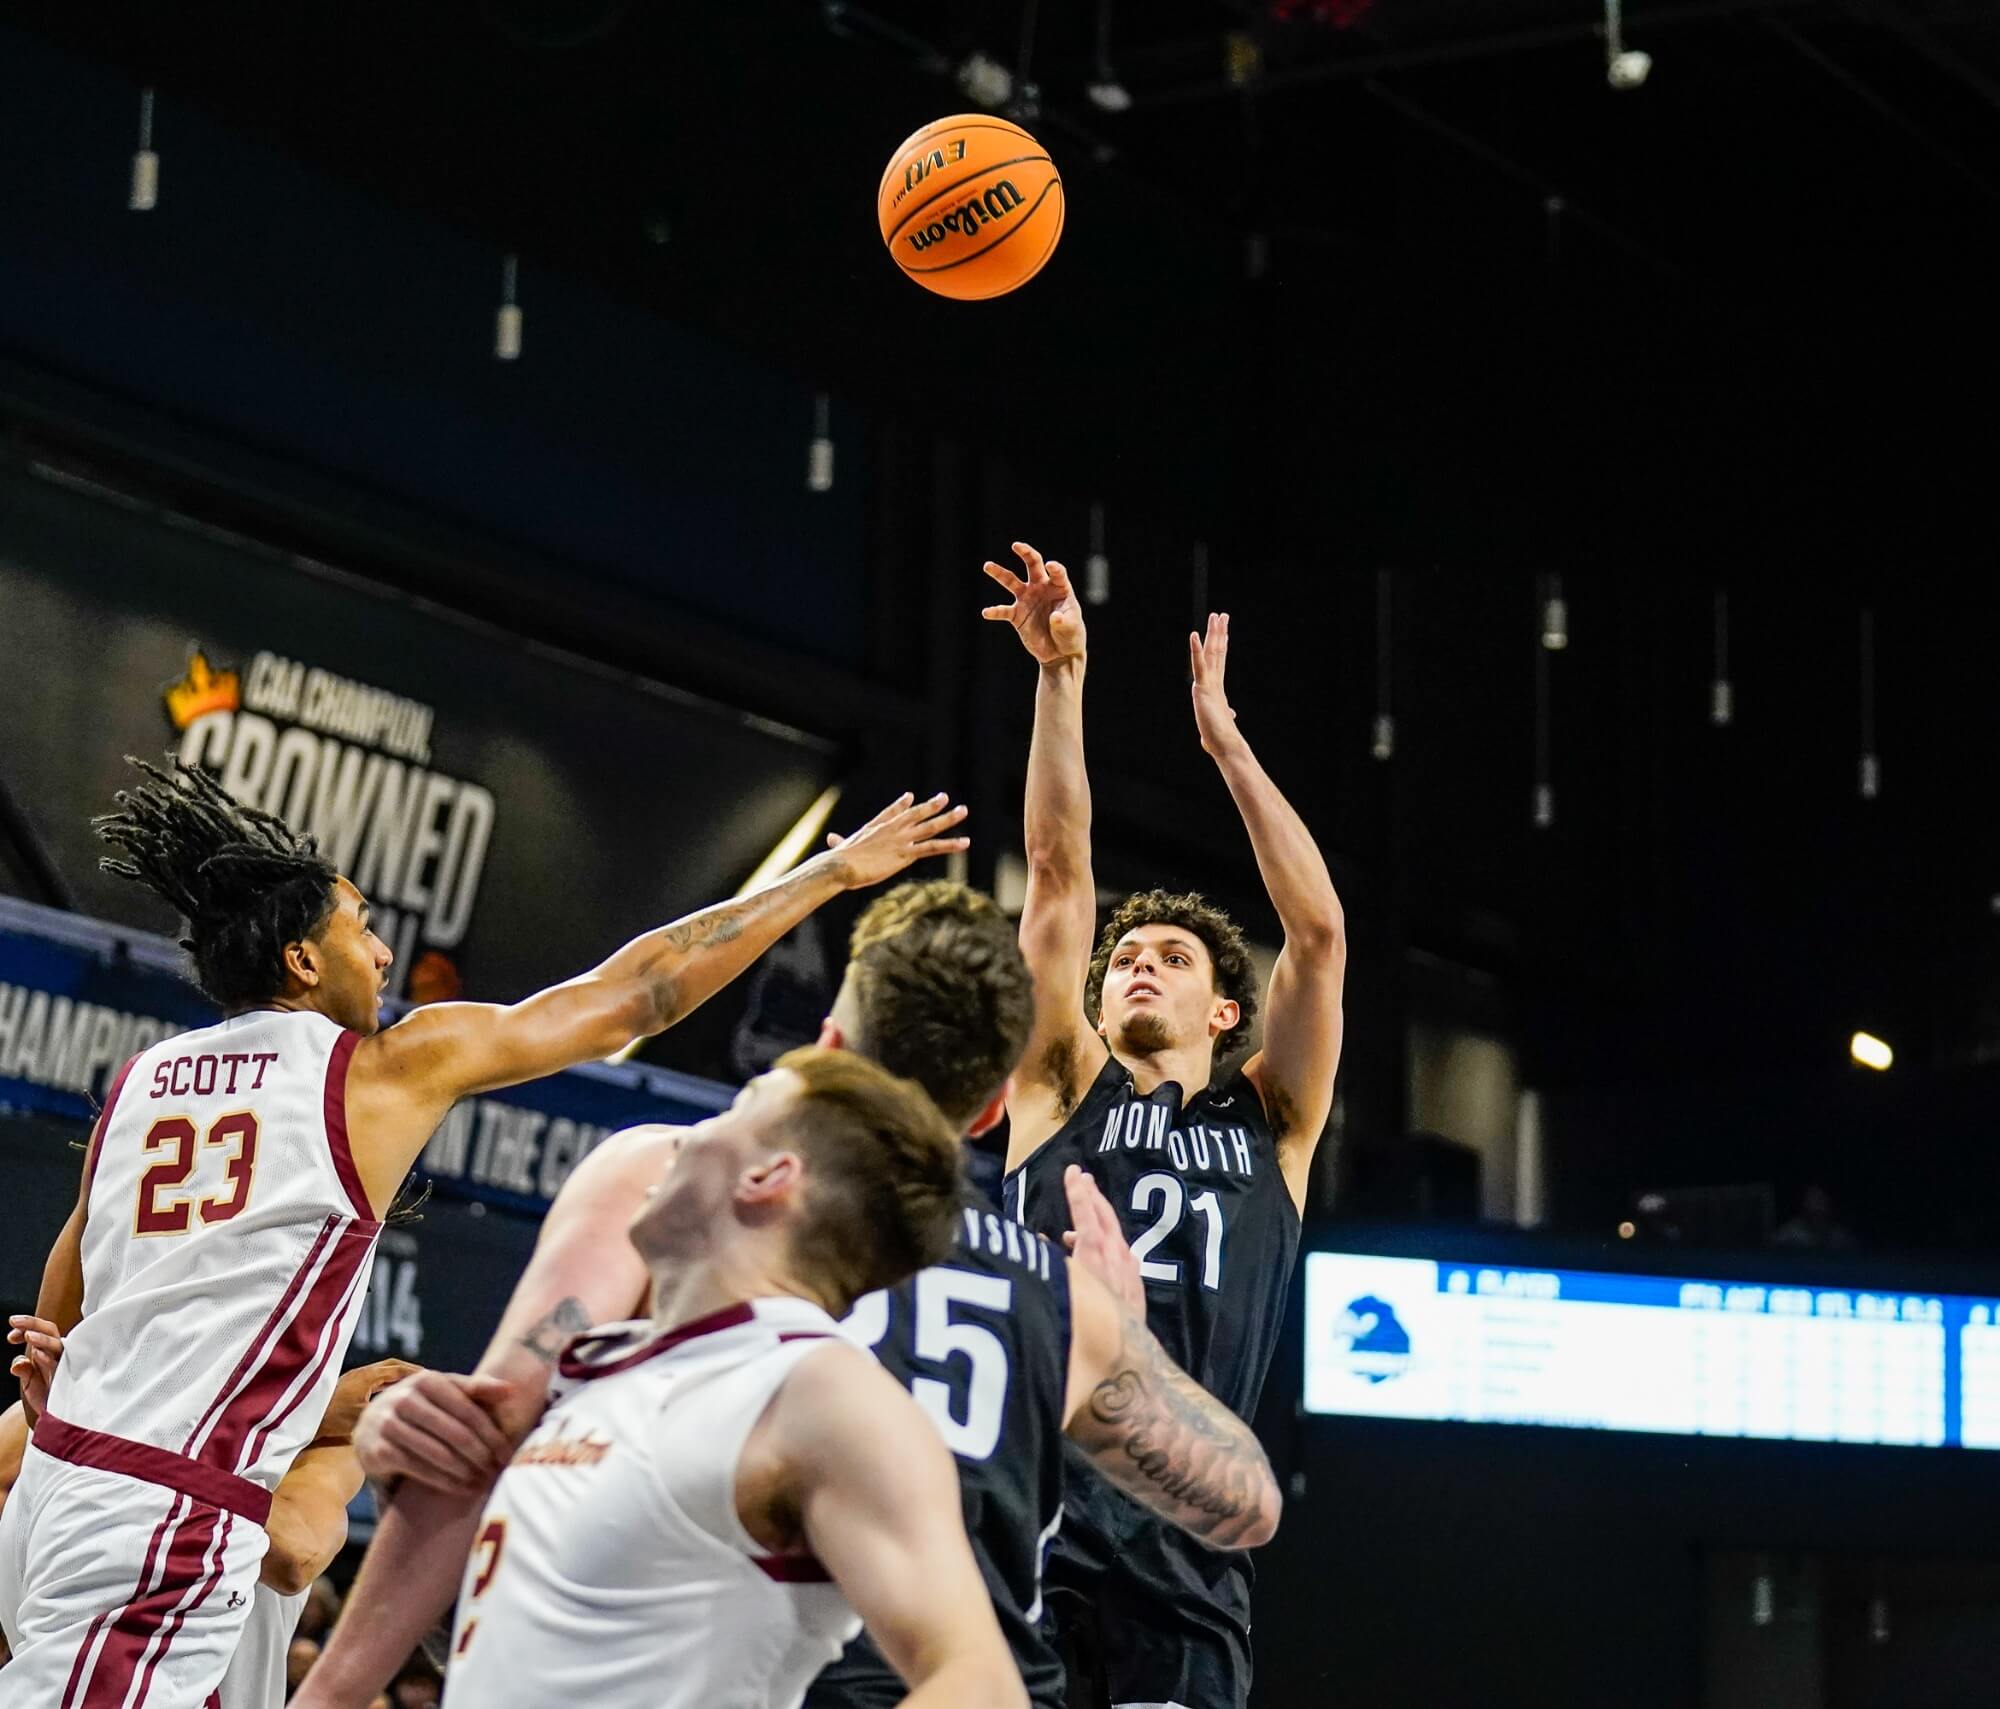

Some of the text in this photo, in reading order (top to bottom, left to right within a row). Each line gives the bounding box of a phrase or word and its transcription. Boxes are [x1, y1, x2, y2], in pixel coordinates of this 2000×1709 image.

[904, 138, 967, 192] EVO
[908, 179, 1026, 252] Wilson
[150, 1052, 279, 1099] SCOTT
[132, 1109, 260, 1239] 23
[1098, 1102, 1252, 1176] MONOUTH
[1130, 1172, 1224, 1290] 21
